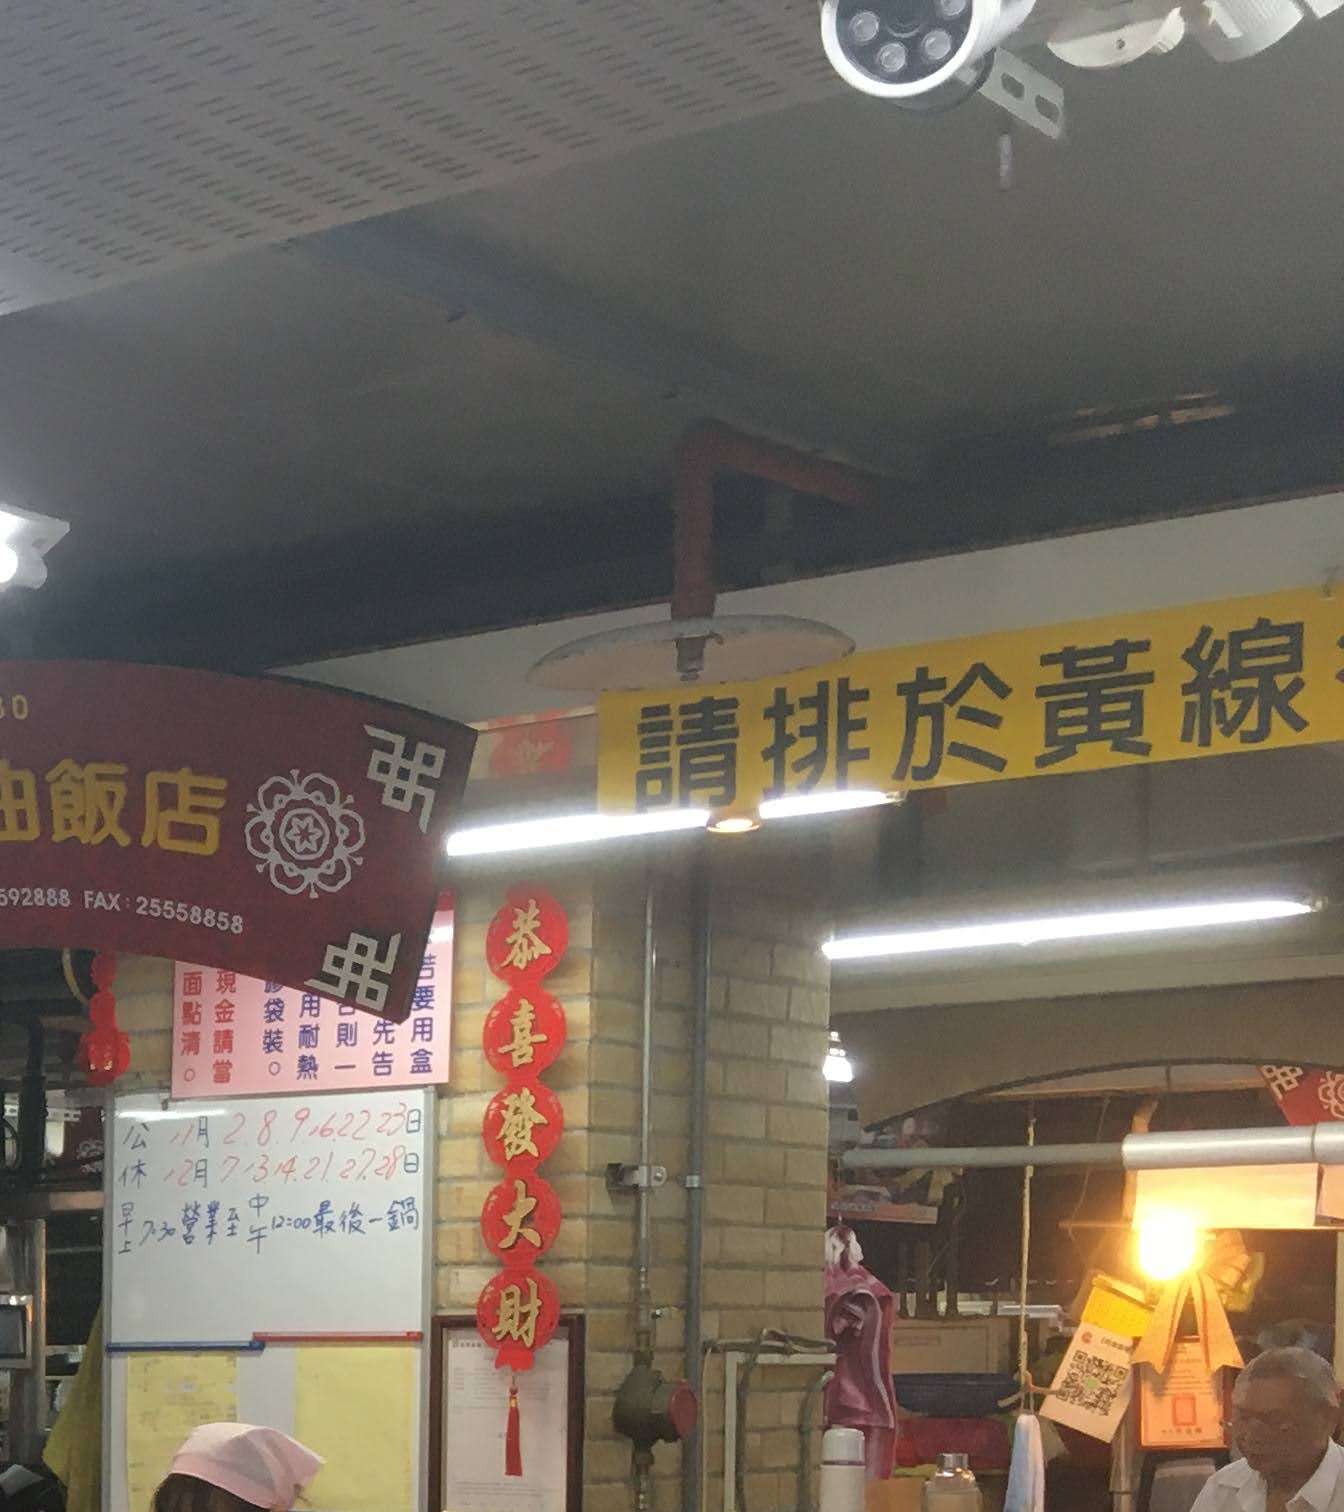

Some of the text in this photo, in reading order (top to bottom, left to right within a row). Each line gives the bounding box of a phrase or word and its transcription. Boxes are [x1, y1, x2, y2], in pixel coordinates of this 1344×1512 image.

[635, 618, 1344, 815] 請排於黃線
[135, 896, 244, 935] 25558858
[212, 970, 237, 1084] 現金請當
[492, 899, 552, 1348] 恭喜發大財
